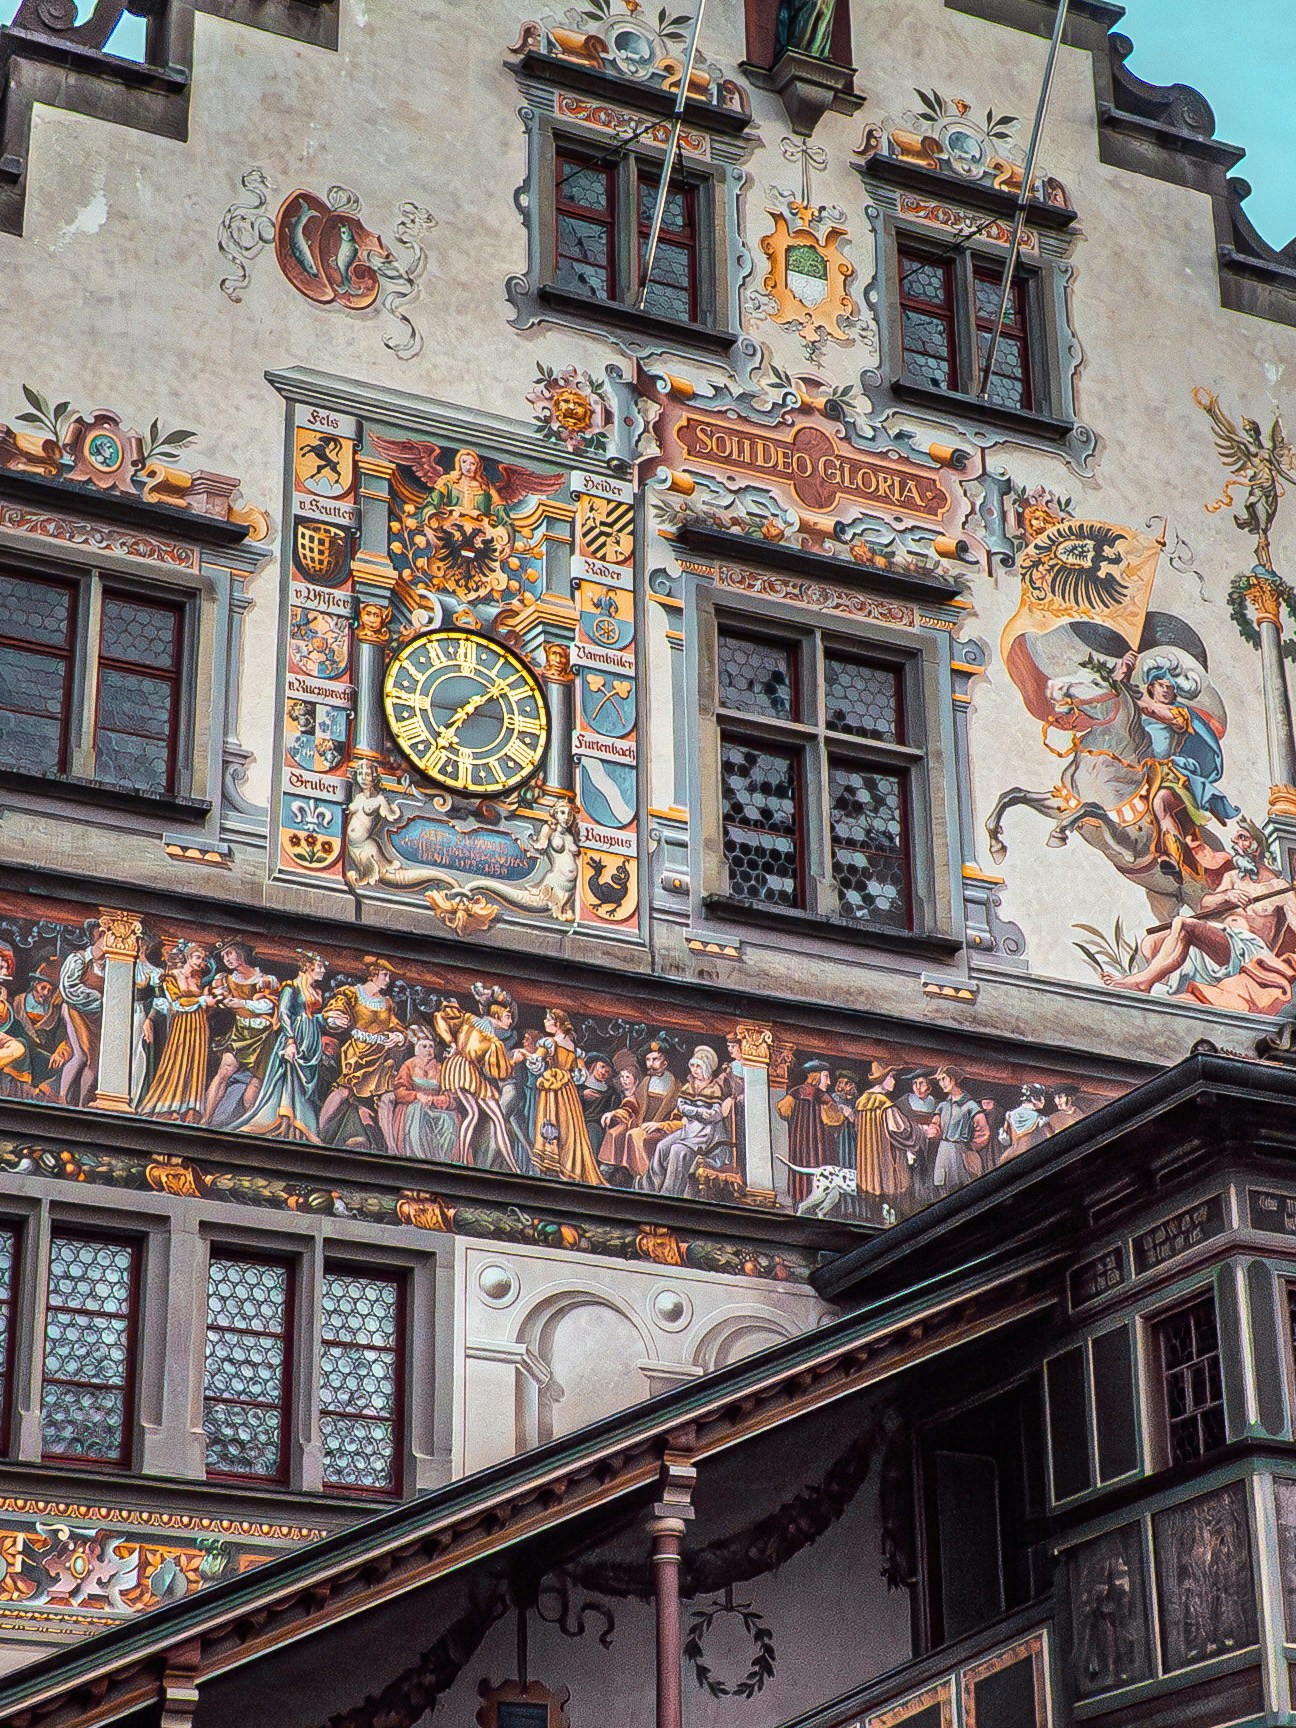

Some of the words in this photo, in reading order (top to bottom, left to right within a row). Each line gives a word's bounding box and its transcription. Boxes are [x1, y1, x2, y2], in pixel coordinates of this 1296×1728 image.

[307, 410, 339, 429] Fels
[695, 425, 751, 463] SOLI
[755, 439, 813, 477] DEO
[818, 455, 926, 507] GLORIA
[583, 474, 623, 496] Heider
[584, 559, 622, 581] Rader
[575, 733, 635, 761] Furtenbach
[289, 771, 338, 795] Gruber
[584, 827, 632, 849] Pappus
